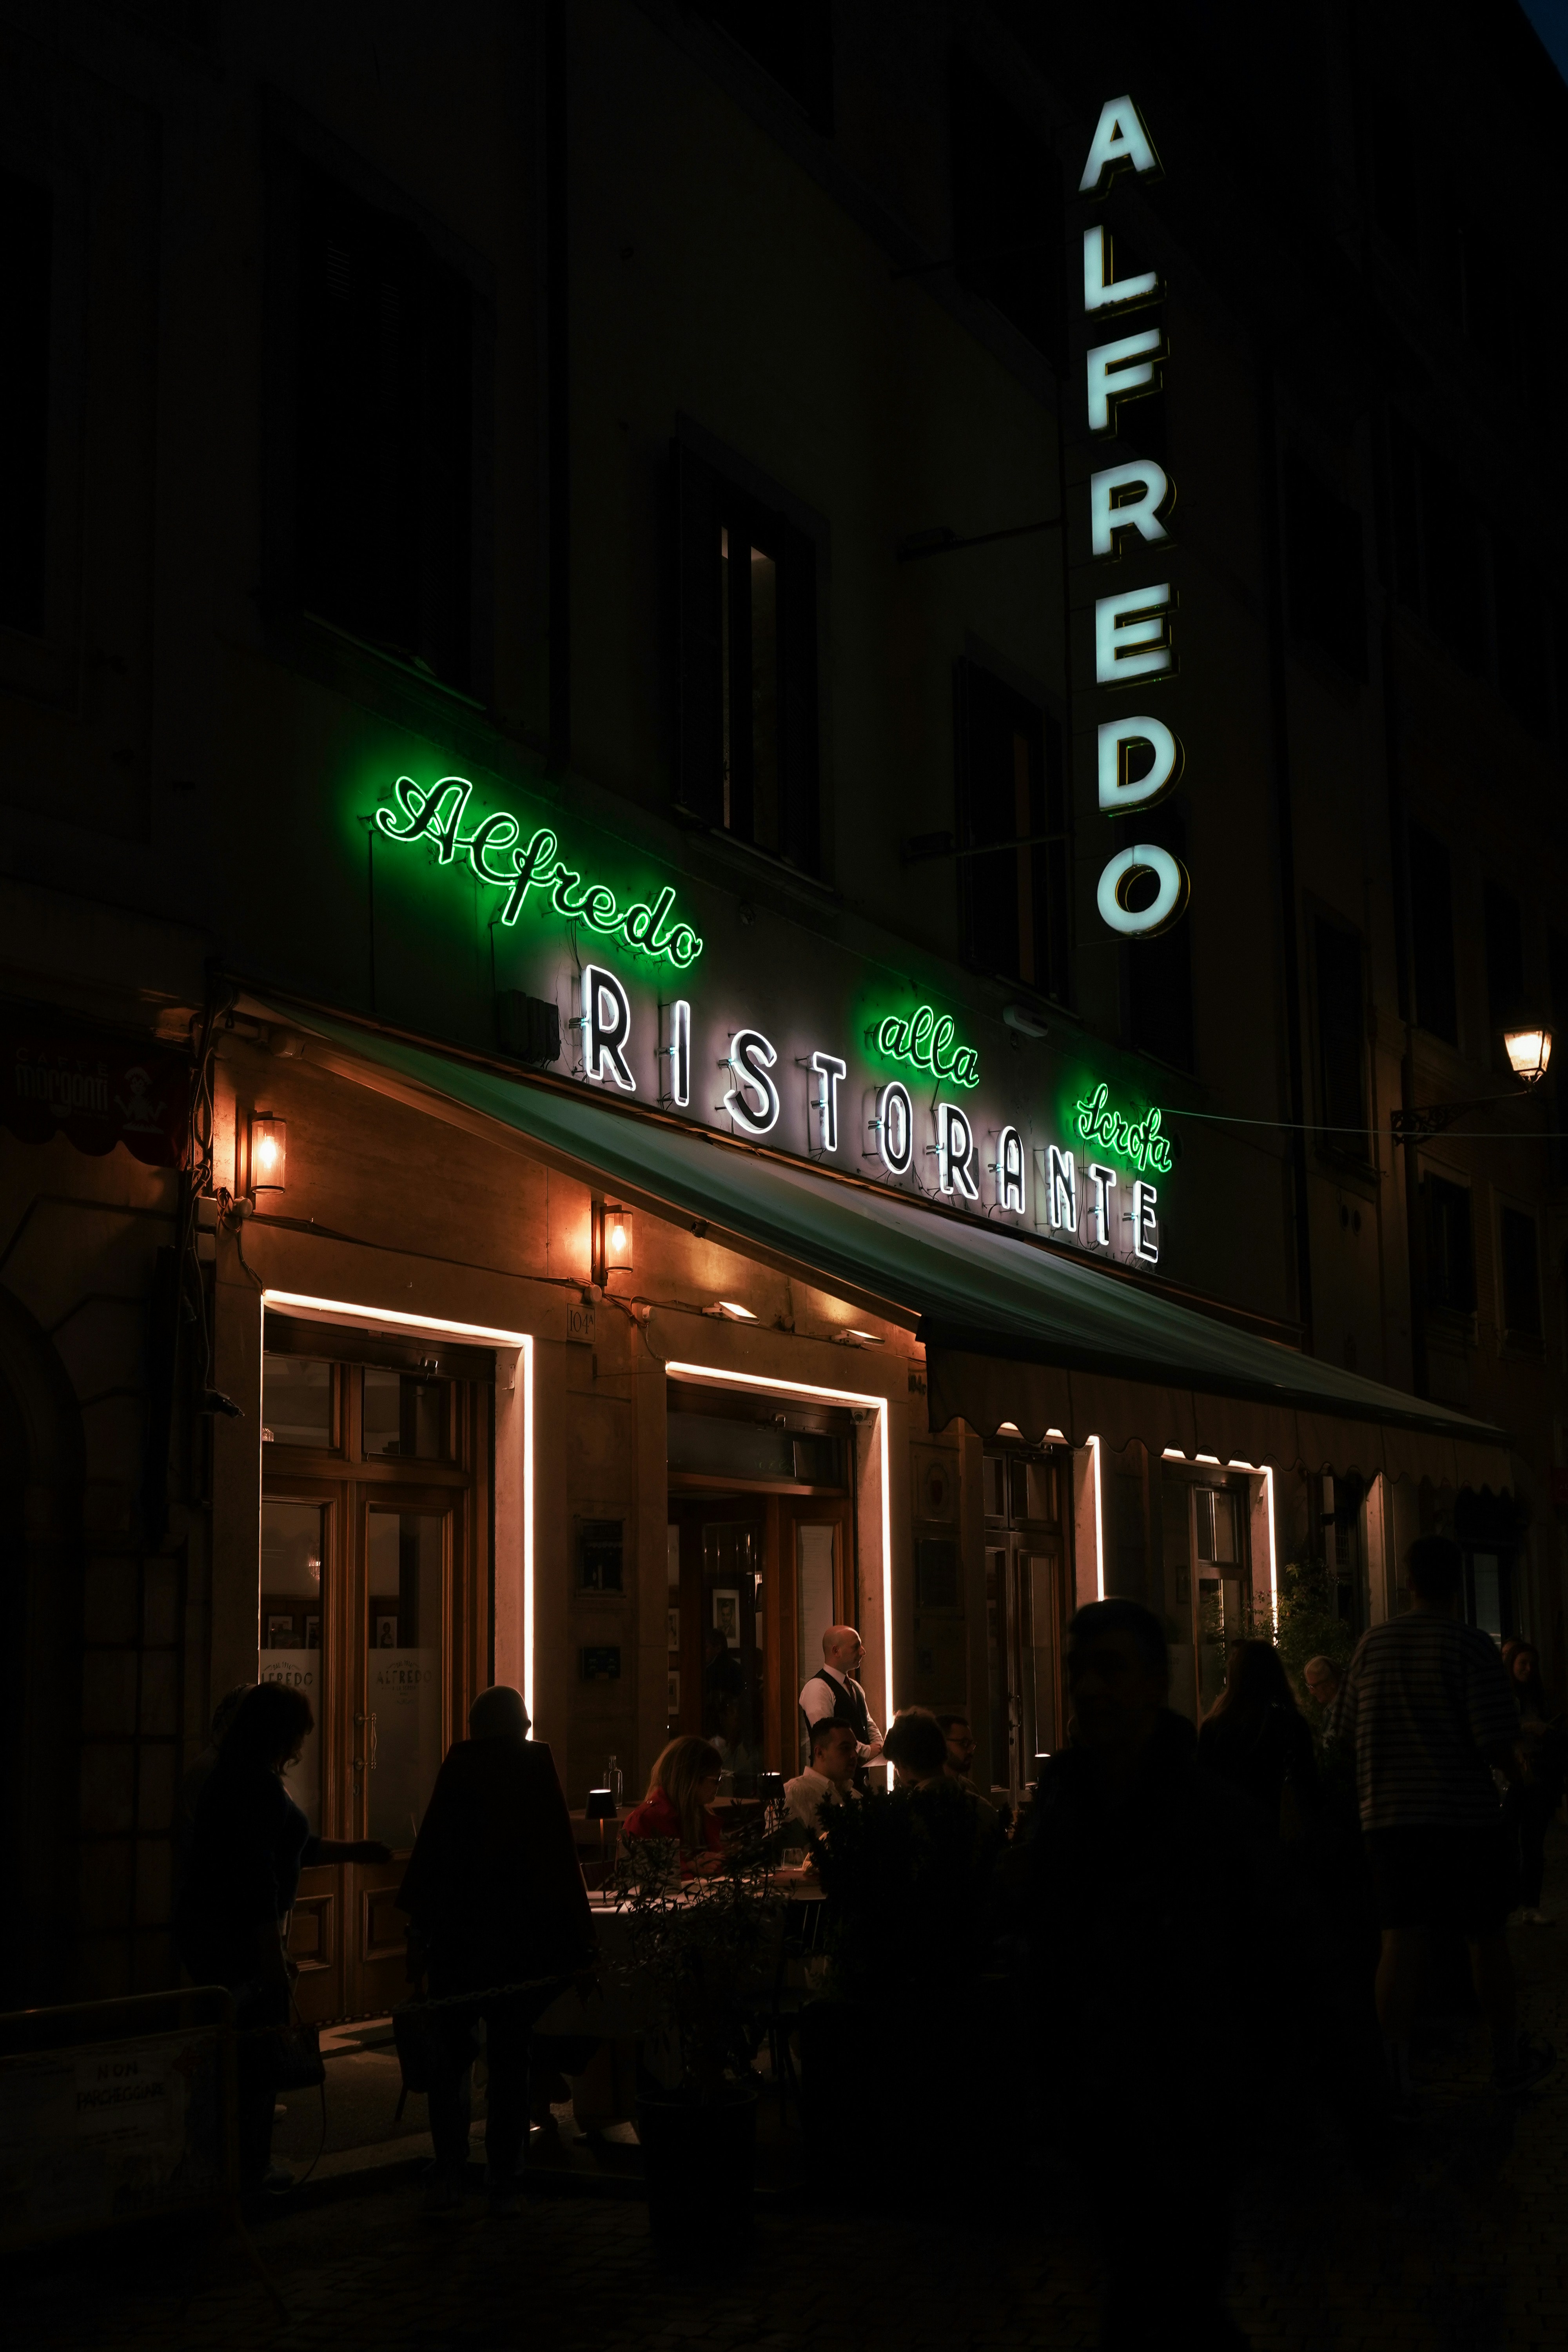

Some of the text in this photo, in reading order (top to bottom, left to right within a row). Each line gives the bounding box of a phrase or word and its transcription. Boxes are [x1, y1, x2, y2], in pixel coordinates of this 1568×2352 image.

[1079, 94, 1181, 935] ALFREDO
[376, 776, 1172, 1172] Alfredo alla Scrofa
[583, 964, 1158, 1263] RISTORANTE
[261, 1672, 314, 1687] LFREDO
[376, 1670, 432, 1684] ALFREDO
[97, 2060, 138, 2081] NON
